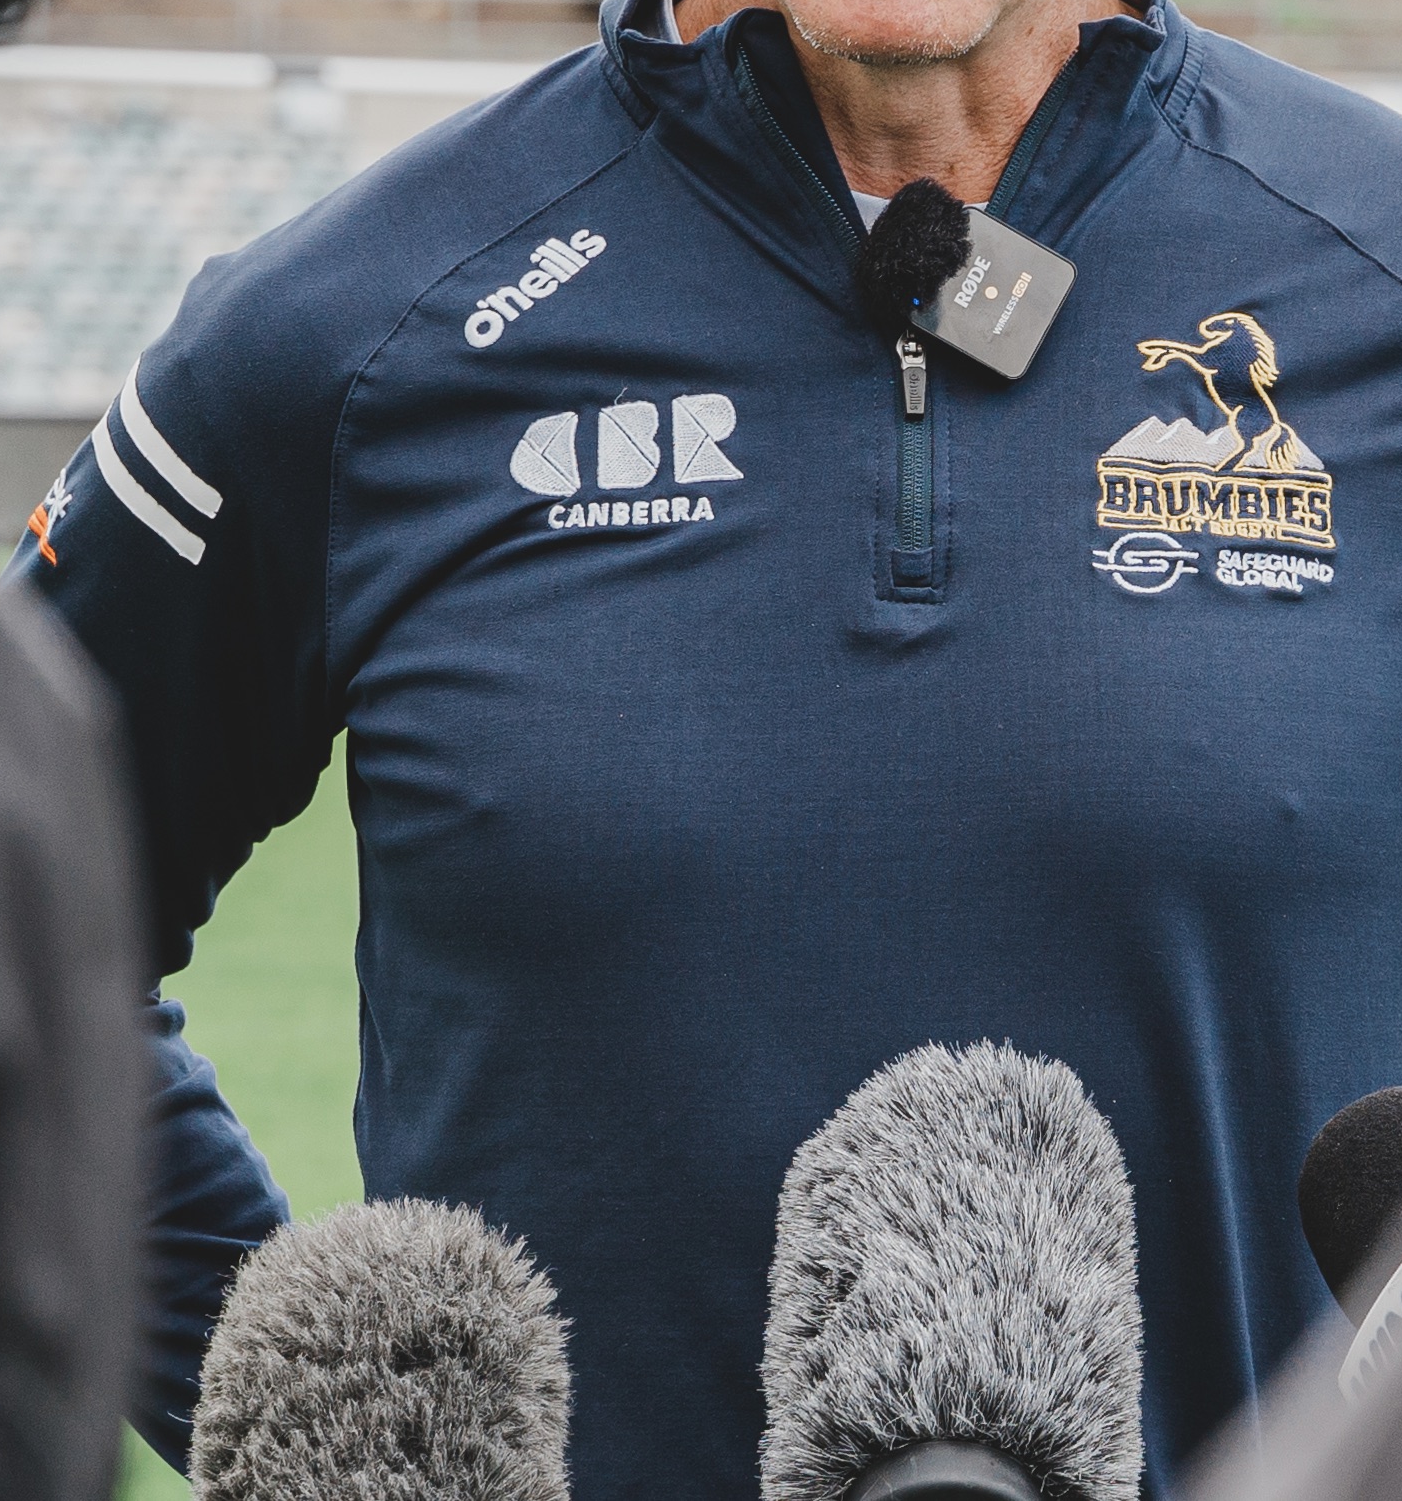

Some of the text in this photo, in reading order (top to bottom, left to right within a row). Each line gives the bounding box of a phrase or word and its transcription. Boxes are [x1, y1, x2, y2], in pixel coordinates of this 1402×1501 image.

[953, 255, 992, 309] RØDE
[992, 295, 1020, 335] WIRELESS
[509, 392, 744, 498] CBR
[547, 496, 715, 530] CANBERRA
[1101, 474, 1329, 532] BRUMBIES
[1209, 520, 1276, 539] RUGBY
[1216, 567, 1304, 593] GLOBAL
[1217, 549, 1334, 583] SAFEGUARD
